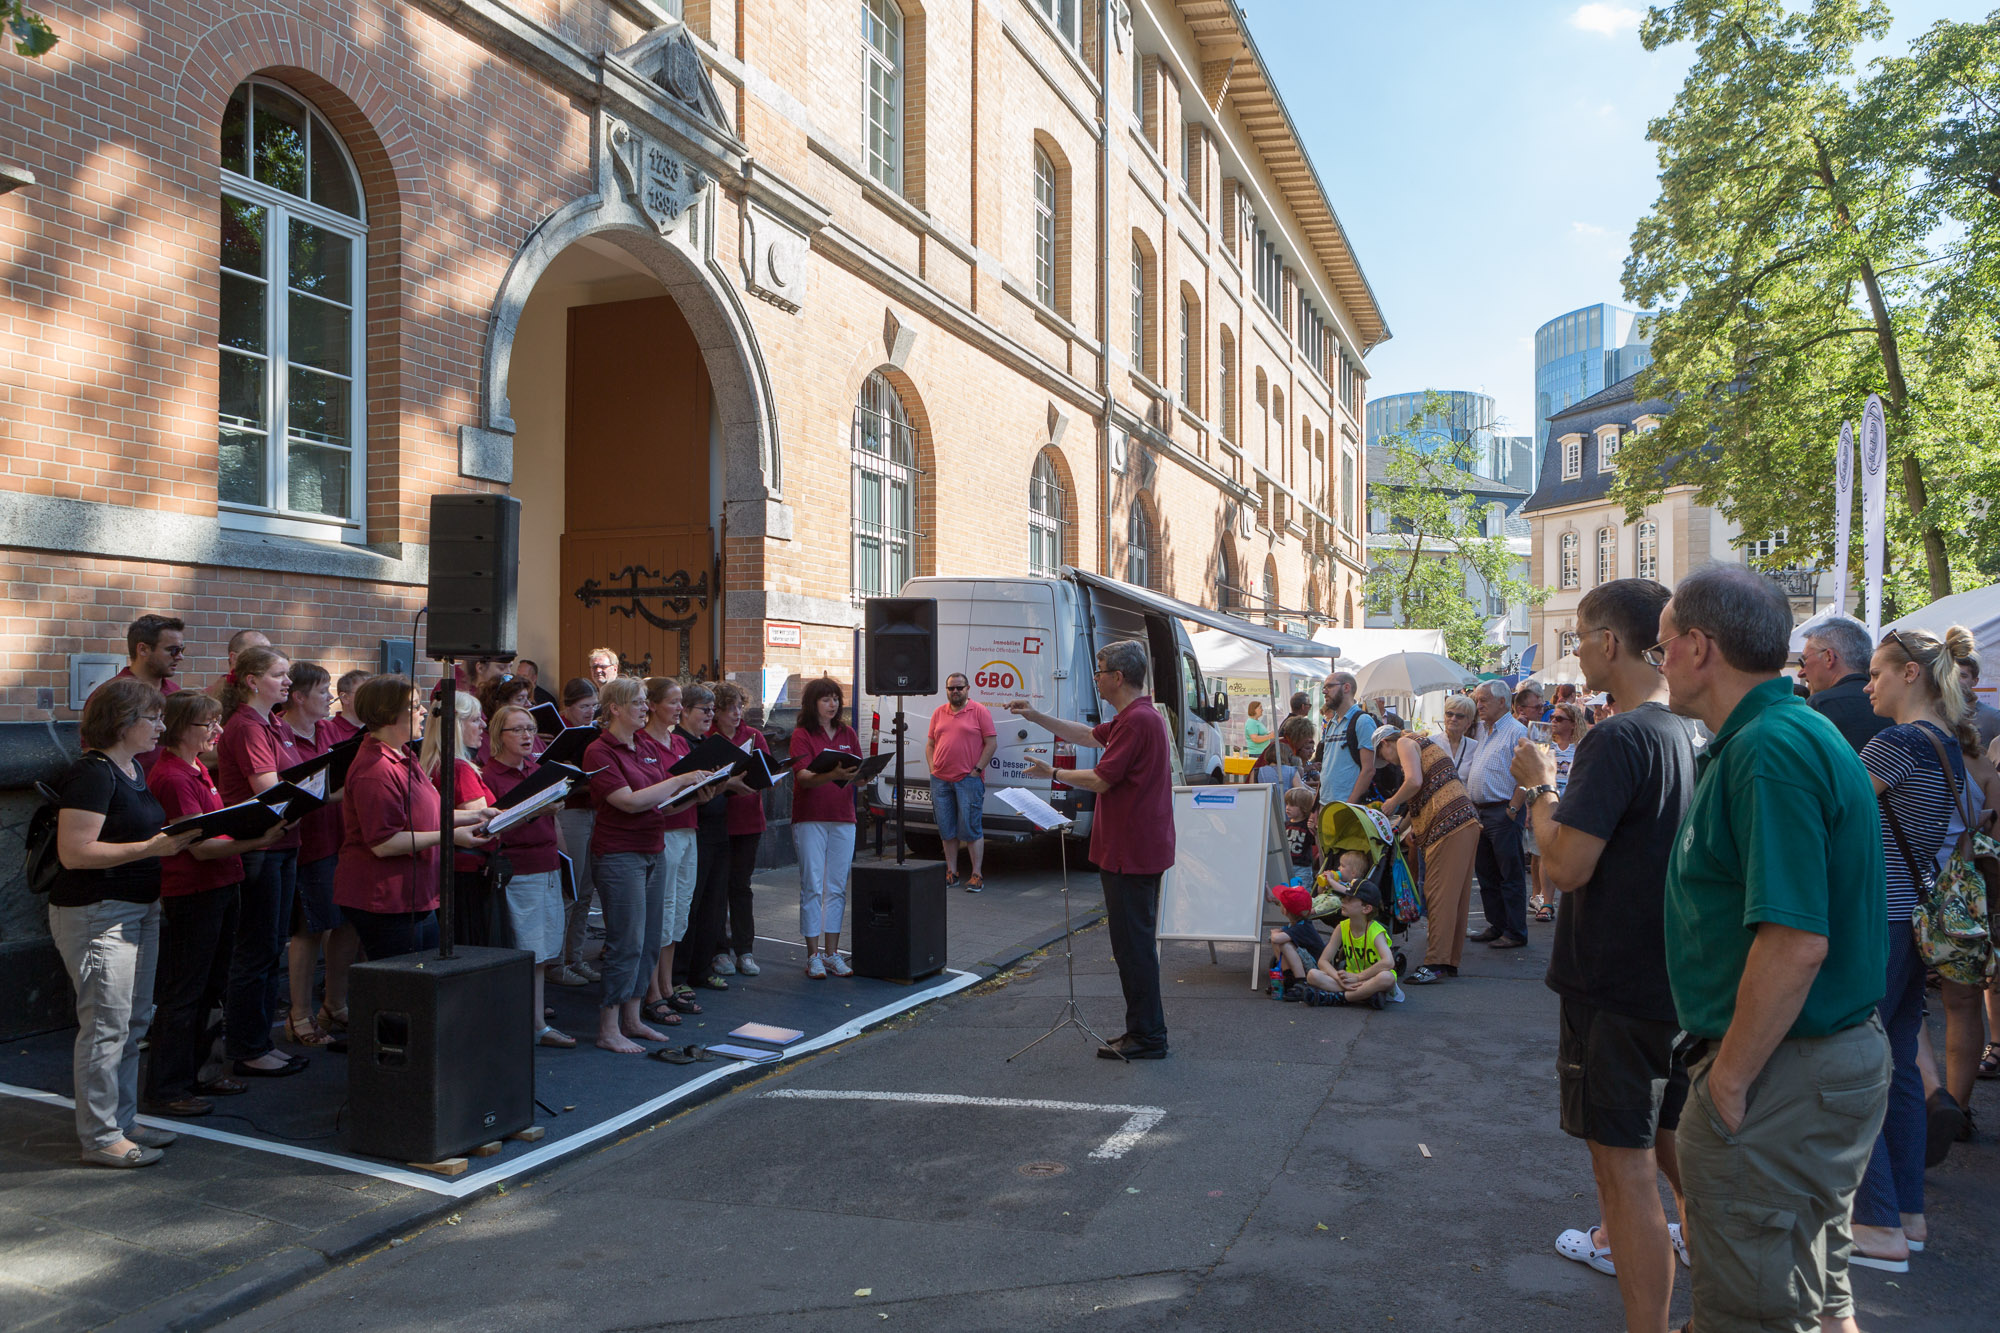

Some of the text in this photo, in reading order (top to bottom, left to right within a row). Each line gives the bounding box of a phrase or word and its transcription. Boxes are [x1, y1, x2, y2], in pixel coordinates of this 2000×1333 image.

[993, 639, 1021, 647] Immobilien
[974, 671, 1014, 689] GBO
[1002, 760, 1028, 769] besser
[1002, 770, 1009, 778] in
